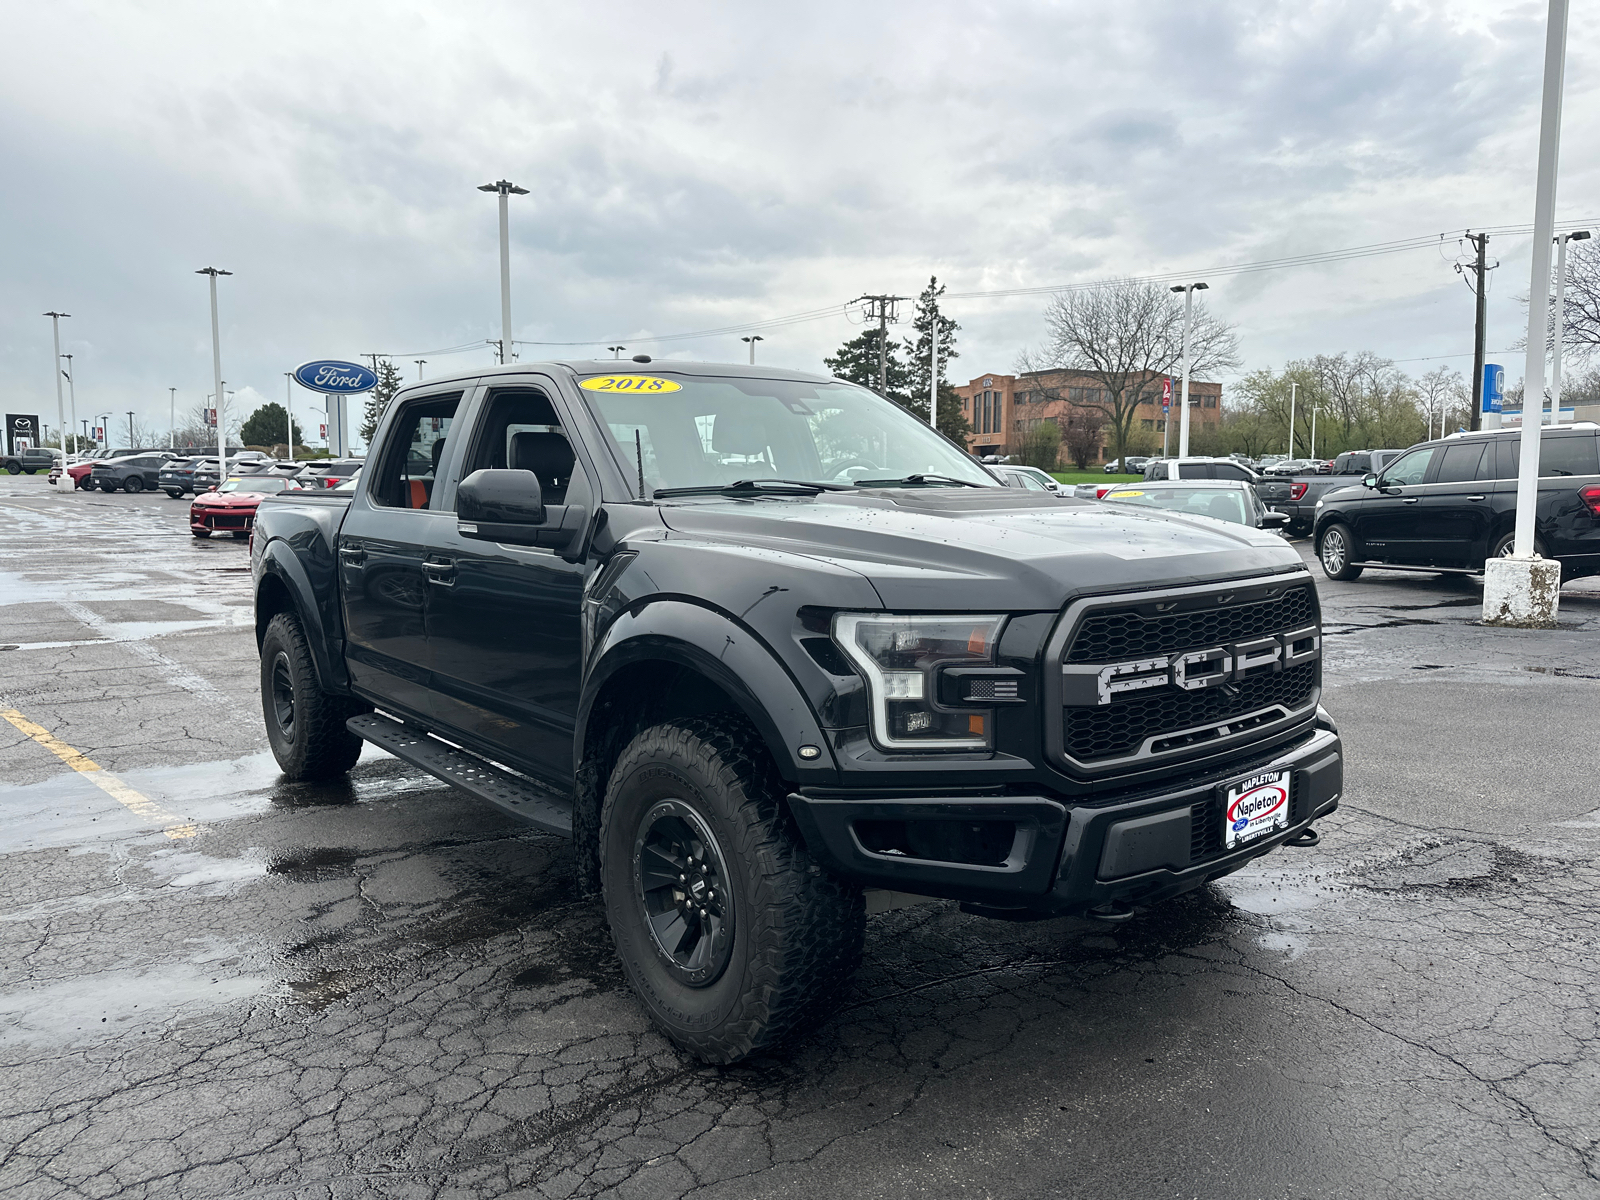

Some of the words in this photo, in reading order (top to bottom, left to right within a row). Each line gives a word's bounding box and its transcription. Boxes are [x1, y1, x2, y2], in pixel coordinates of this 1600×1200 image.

[314, 365, 362, 387] Ford
[598, 378, 665, 390] 2018
[1097, 625, 1320, 705] FORD
[1241, 771, 1280, 793] NAPLETON
[1237, 795, 1278, 818] Napleton
[1235, 818, 1247, 831] Ford
[1255, 812, 1282, 826] Libertyville
[1241, 826, 1274, 843] LIBERTYVILLE
